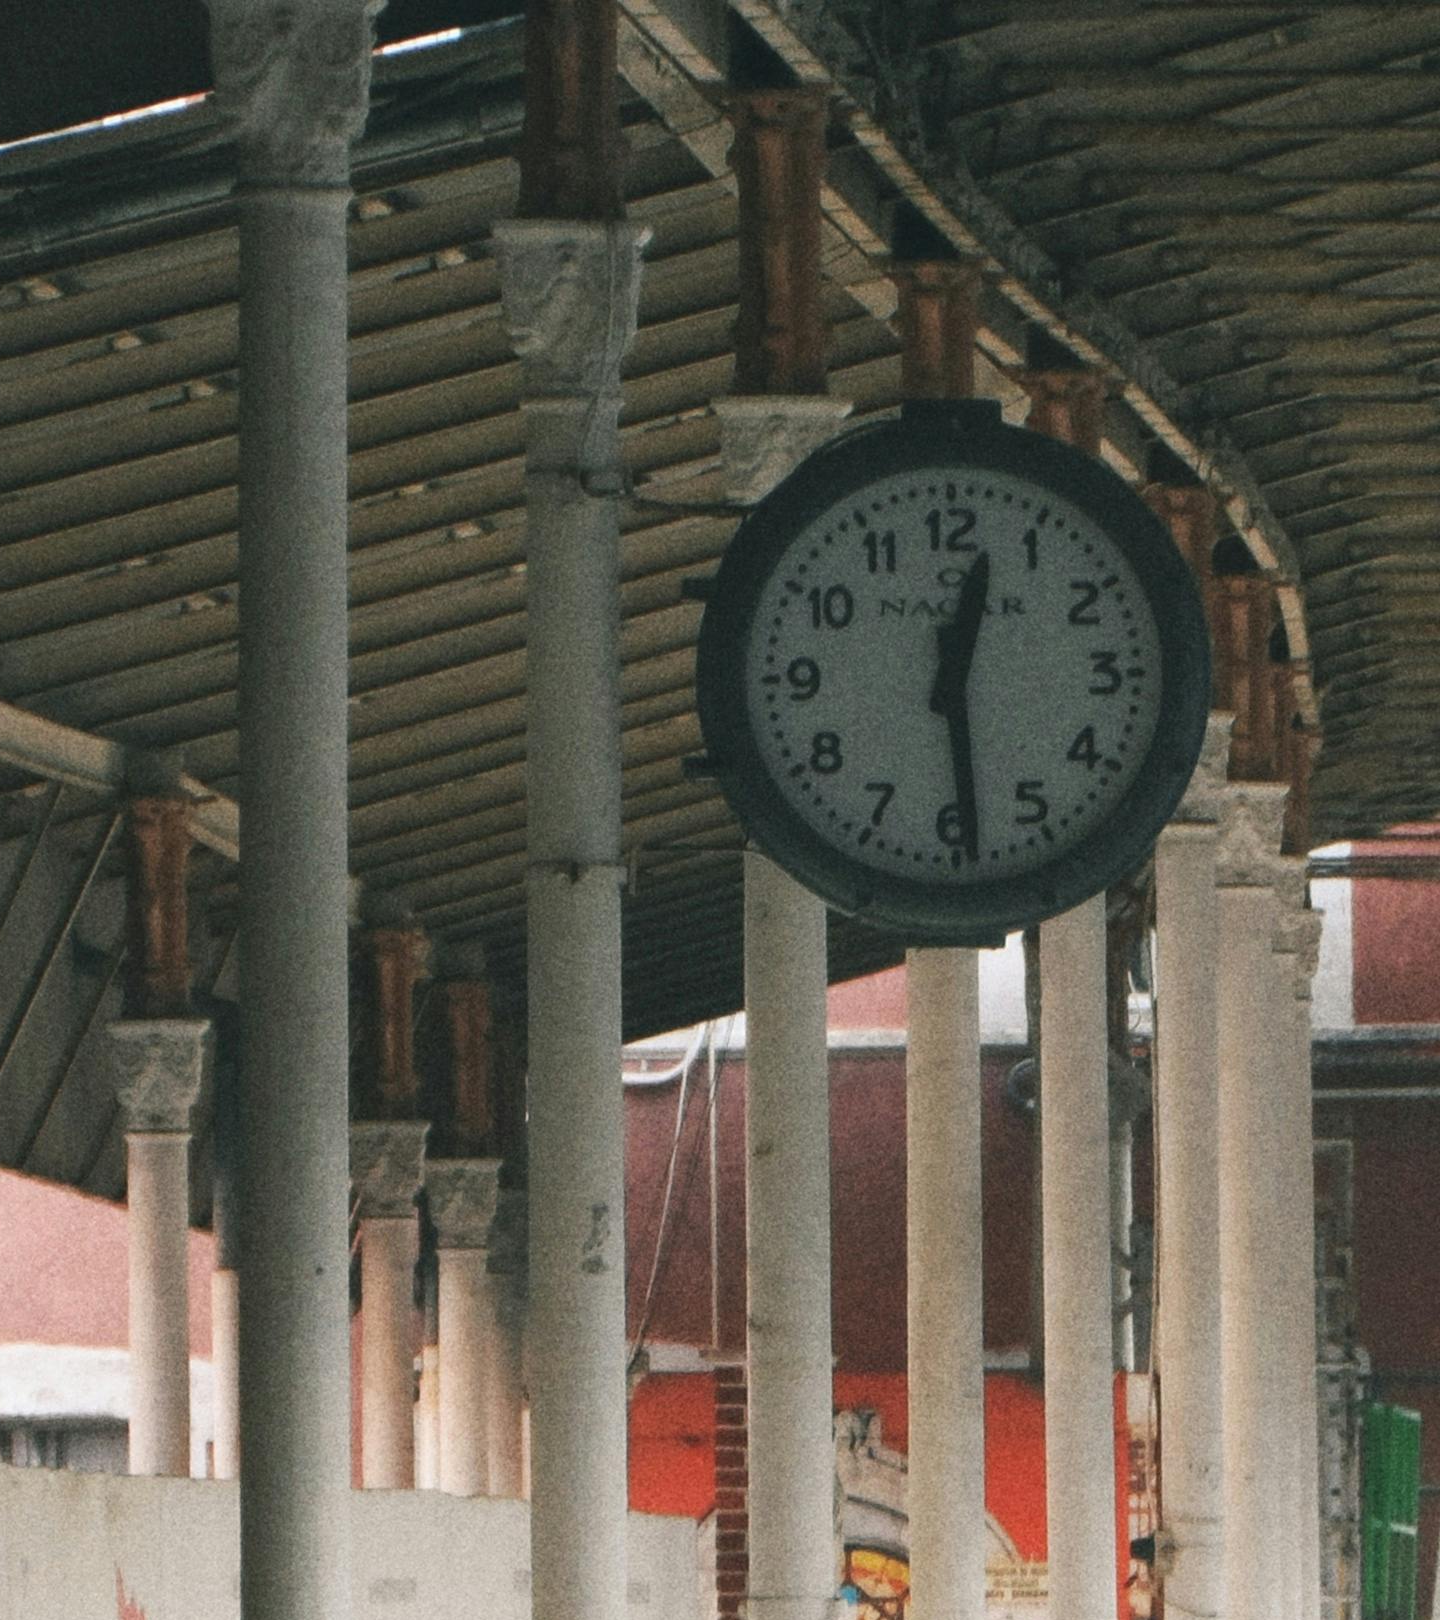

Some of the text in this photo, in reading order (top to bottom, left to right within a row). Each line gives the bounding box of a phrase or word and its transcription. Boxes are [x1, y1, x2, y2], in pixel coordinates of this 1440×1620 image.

[863, 529, 897, 574] 11
[924, 507, 978, 552] 12
[1021, 528, 1039, 571] 1
[807, 584, 854, 630] 10
[879, 597, 1028, 618] NACR
[1067, 580, 1101, 626] 2
[786, 656, 822, 701] 9
[1087, 651, 1123, 695] 3
[810, 730, 844, 775] 8
[1066, 724, 1103, 771] 4
[864, 782, 896, 826] 7
[936, 802, 966, 848] 6
[1015, 780, 1049, 825] 5
